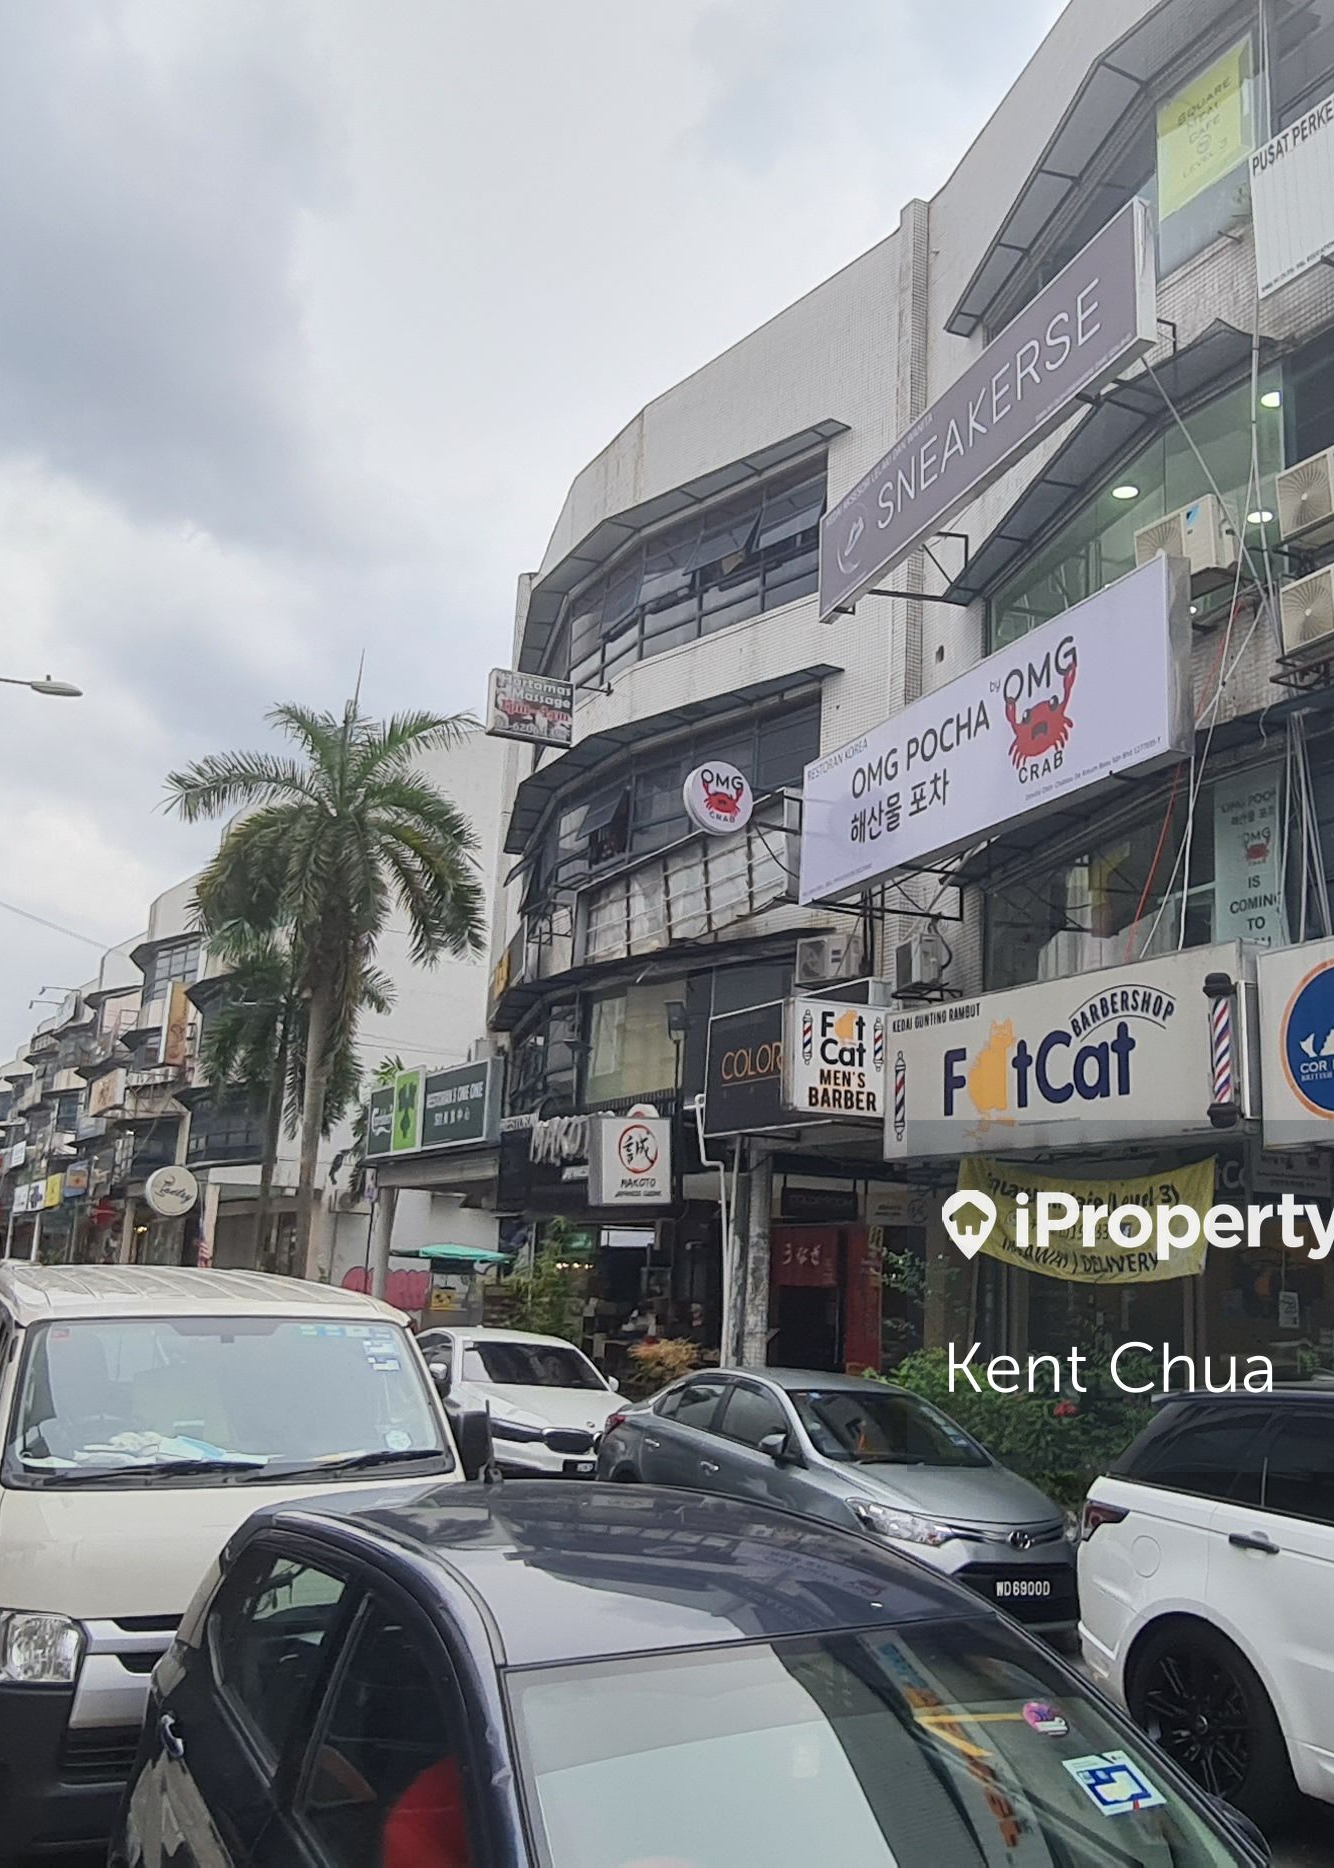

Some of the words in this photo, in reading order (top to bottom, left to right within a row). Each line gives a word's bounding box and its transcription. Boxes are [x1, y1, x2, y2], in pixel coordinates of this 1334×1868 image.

[1252, 133, 1290, 177] PUSAT
[877, 278, 1101, 529] SNEAKERSE
[513, 687, 571, 709] Massage
[852, 747, 899, 799] OMG
[906, 700, 990, 771] POCHA
[989, 677, 1002, 694] by
[1003, 635, 1077, 702] OMG
[701, 769, 744, 790] OMG
[1018, 751, 1063, 784] CRAB
[851, 791, 900, 844] 해산물
[908, 768, 950, 818] 포차
[1248, 875, 1261, 888] IS
[1247, 916, 1265, 931] TO
[893, 1019, 913, 1034] KEDAI
[915, 1012, 947, 1030] GUNTING
[1071, 987, 1175, 1039] BARBERSHOP
[821, 1038, 867, 1067] Cat
[819, 1069, 865, 1088] MEN'S
[1299, 1060, 1328, 1074] COR
[808, 1087, 877, 1112] BARBER
[623, 1134, 655, 1165] 誠
[620, 1178, 657, 1188] MAKOTO
